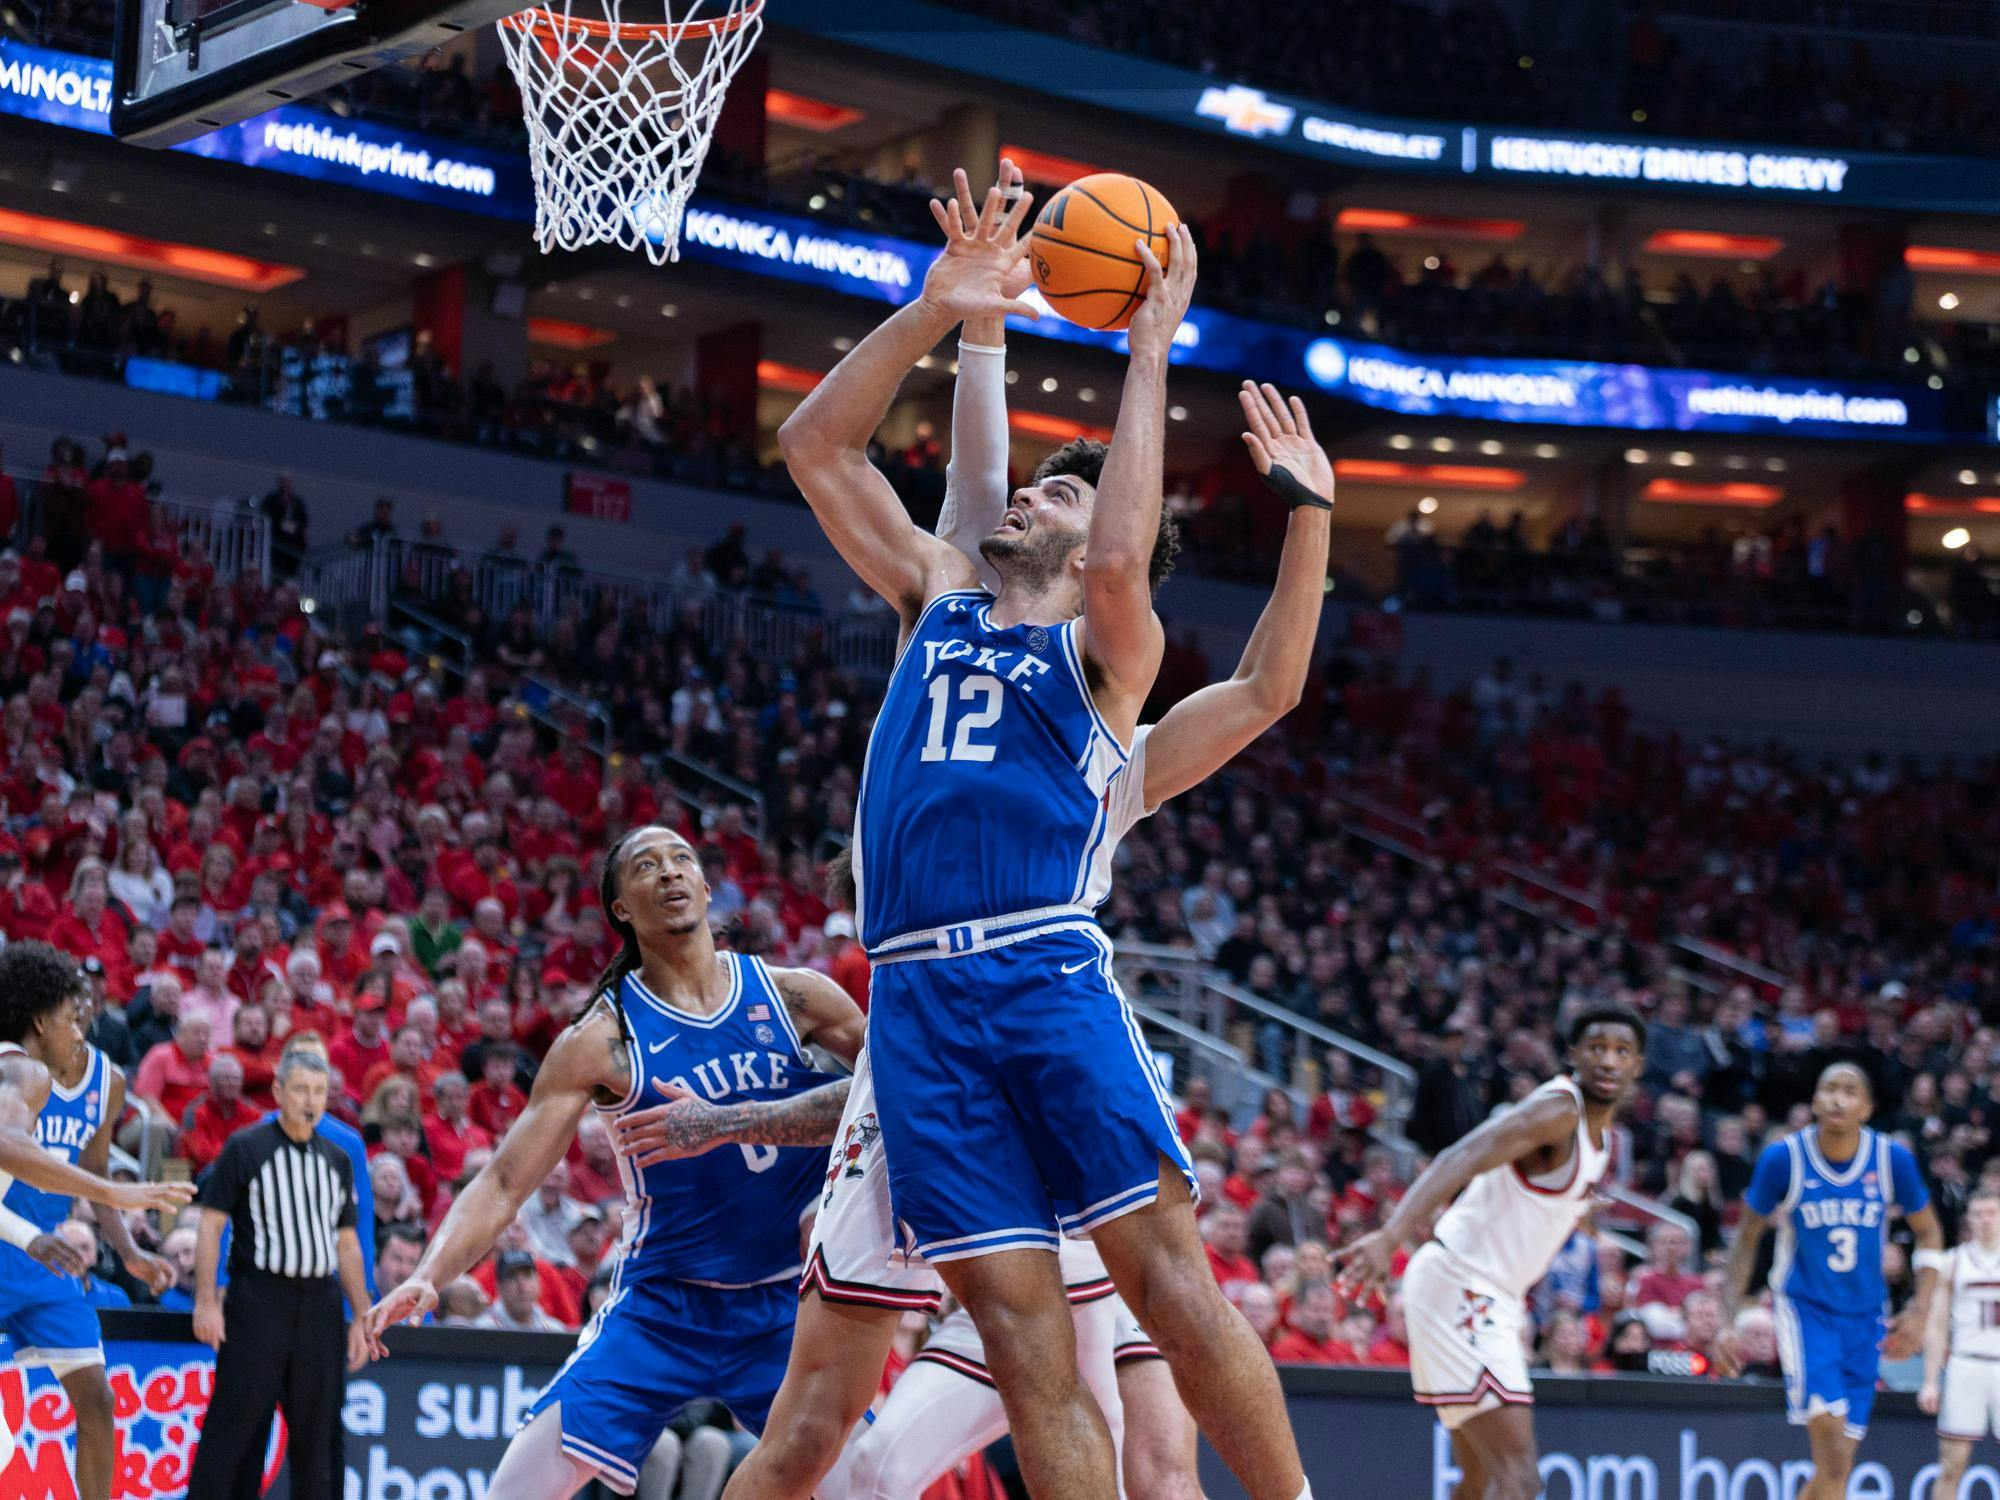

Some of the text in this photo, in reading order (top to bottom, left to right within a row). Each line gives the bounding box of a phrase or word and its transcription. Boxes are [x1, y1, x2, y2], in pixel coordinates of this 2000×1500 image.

[0, 56, 113, 114] MINOLT
[264, 121, 495, 196] rethinkprint.com
[1491, 136, 1643, 178] KENTUCKY
[1643, 147, 1748, 187] DRIVES
[1748, 154, 1849, 192] CHEVY
[685, 208, 911, 287] KONICA MINOLTA
[1348, 357, 1577, 408] KONICA MINOLTA
[1687, 385, 1908, 425] rethinkprint.com
[920, 673, 1004, 762] 12
[1801, 1199, 1882, 1228] DUKE
[1826, 1227, 1857, 1273] 3
[341, 1379, 386, 1436] a
